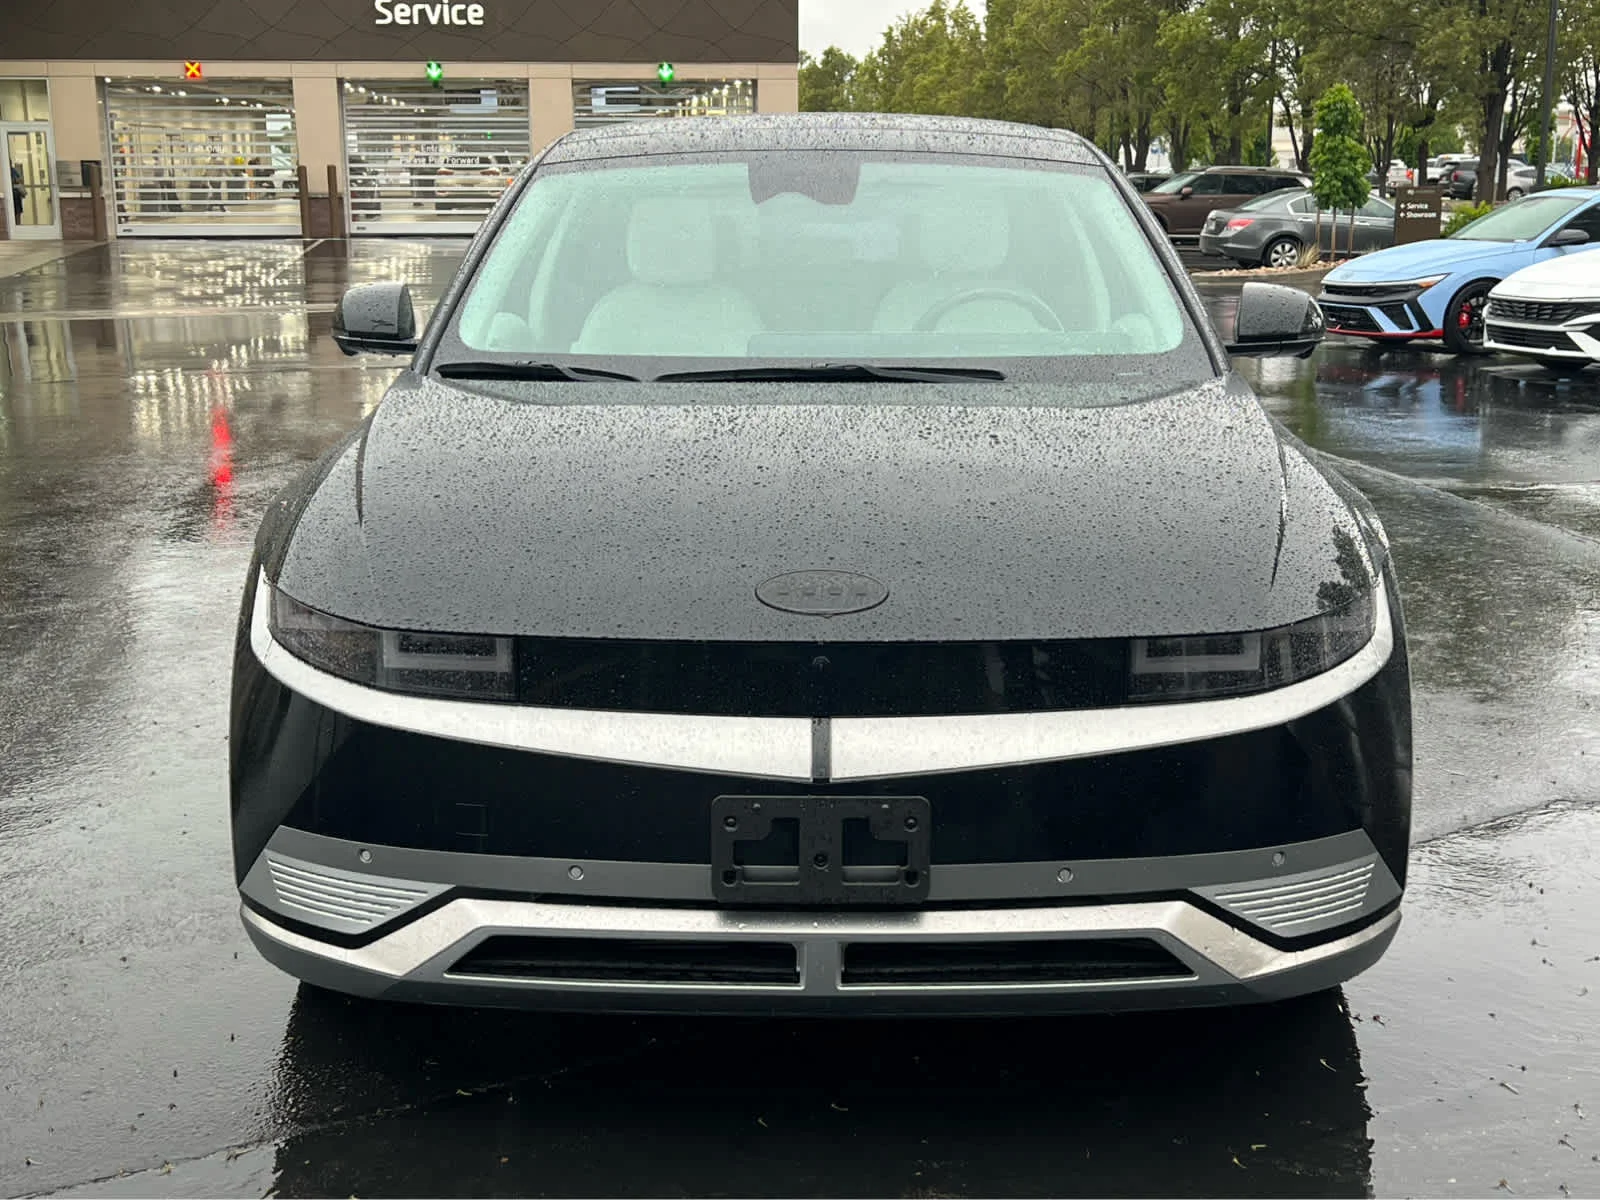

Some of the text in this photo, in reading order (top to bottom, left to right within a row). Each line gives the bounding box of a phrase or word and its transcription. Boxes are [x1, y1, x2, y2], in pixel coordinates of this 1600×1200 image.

[374, 0, 485, 25] Service
[446, 156, 480, 165] Forward
[1406, 202, 1429, 210] Service
